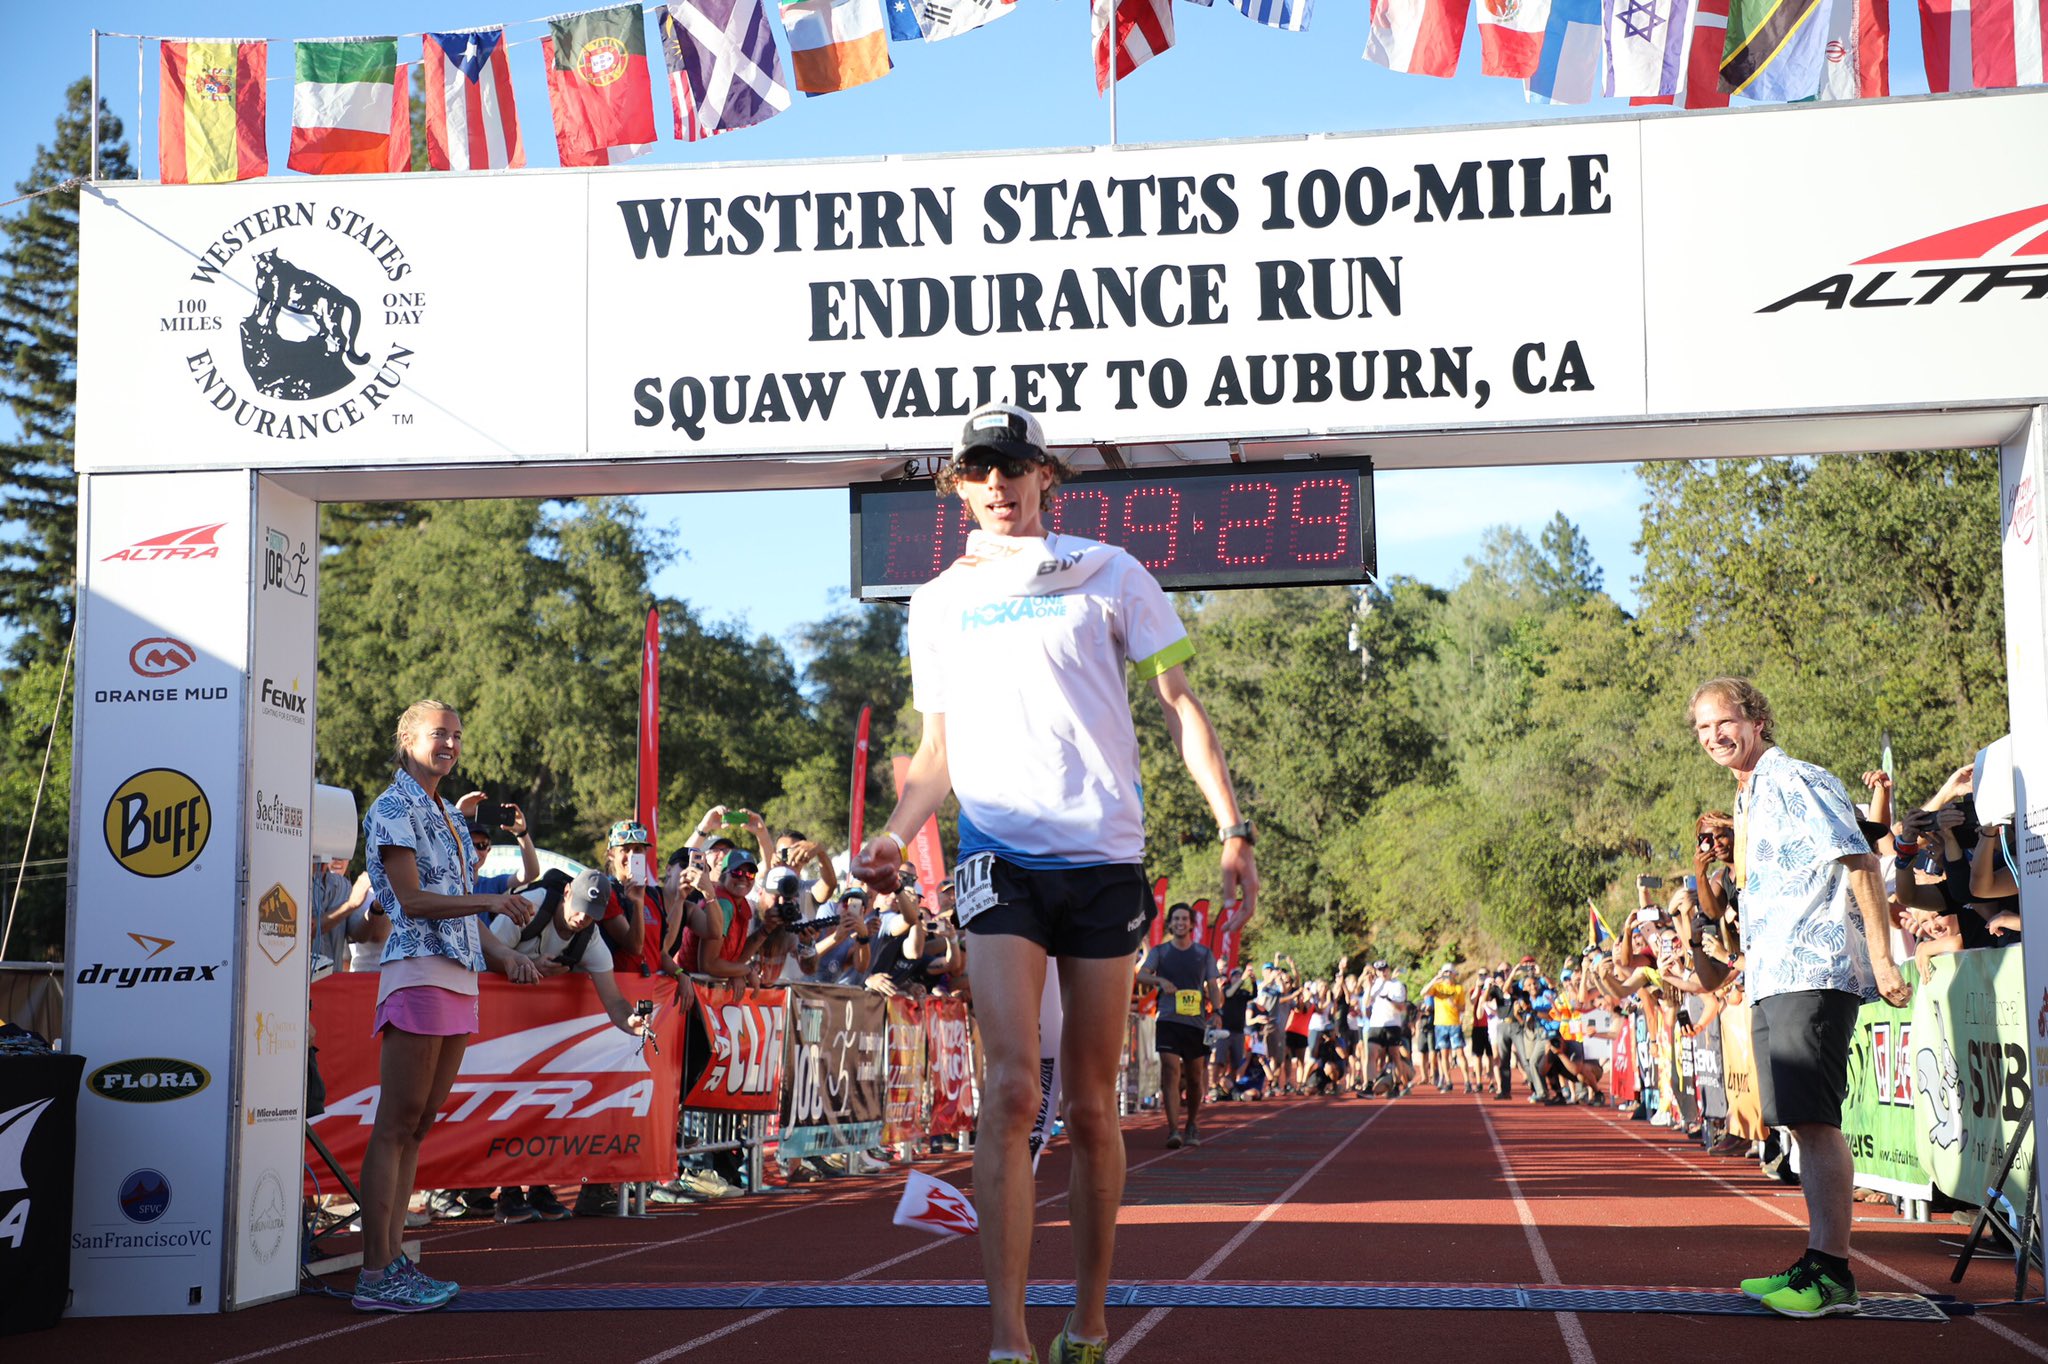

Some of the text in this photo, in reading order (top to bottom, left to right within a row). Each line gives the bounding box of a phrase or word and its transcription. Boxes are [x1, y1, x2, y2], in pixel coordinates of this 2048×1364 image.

[617, 154, 1612, 260] WESTERN STATES 100-MILE
[190, 201, 412, 288] WESTERN STATES
[1753, 262, 2048, 314] ALTR
[177, 299, 207, 314] 100
[383, 292, 426, 309] ONE
[808, 255, 1404, 342] ENDURANCE RUN
[160, 316, 222, 332] MILES
[384, 310, 424, 326] DAY
[186, 341, 416, 440] ENDURANCE RUN
[633, 339, 1595, 441] SQUAW VALLEY TO AUBURN, CA
[392, 413, 414, 425] TM
[100, 546, 220, 562] ALTRA
[962, 595, 1034, 632] HOKA
[1035, 605, 1067, 618] ONE
[95, 687, 228, 703] ORANGE MUD
[256, 821, 274, 831] ULTRA
[77, 963, 220, 989] drymax
[722, 1005, 783, 1093] CLIF
[103, 1072, 199, 1089] FLORA
[307, 1079, 654, 1126] ATRA
[487, 1134, 641, 1159] FOOTWEAR
[139, 1204, 162, 1215] SFVC
[72, 1229, 212, 1249] SanFranciscoVC
